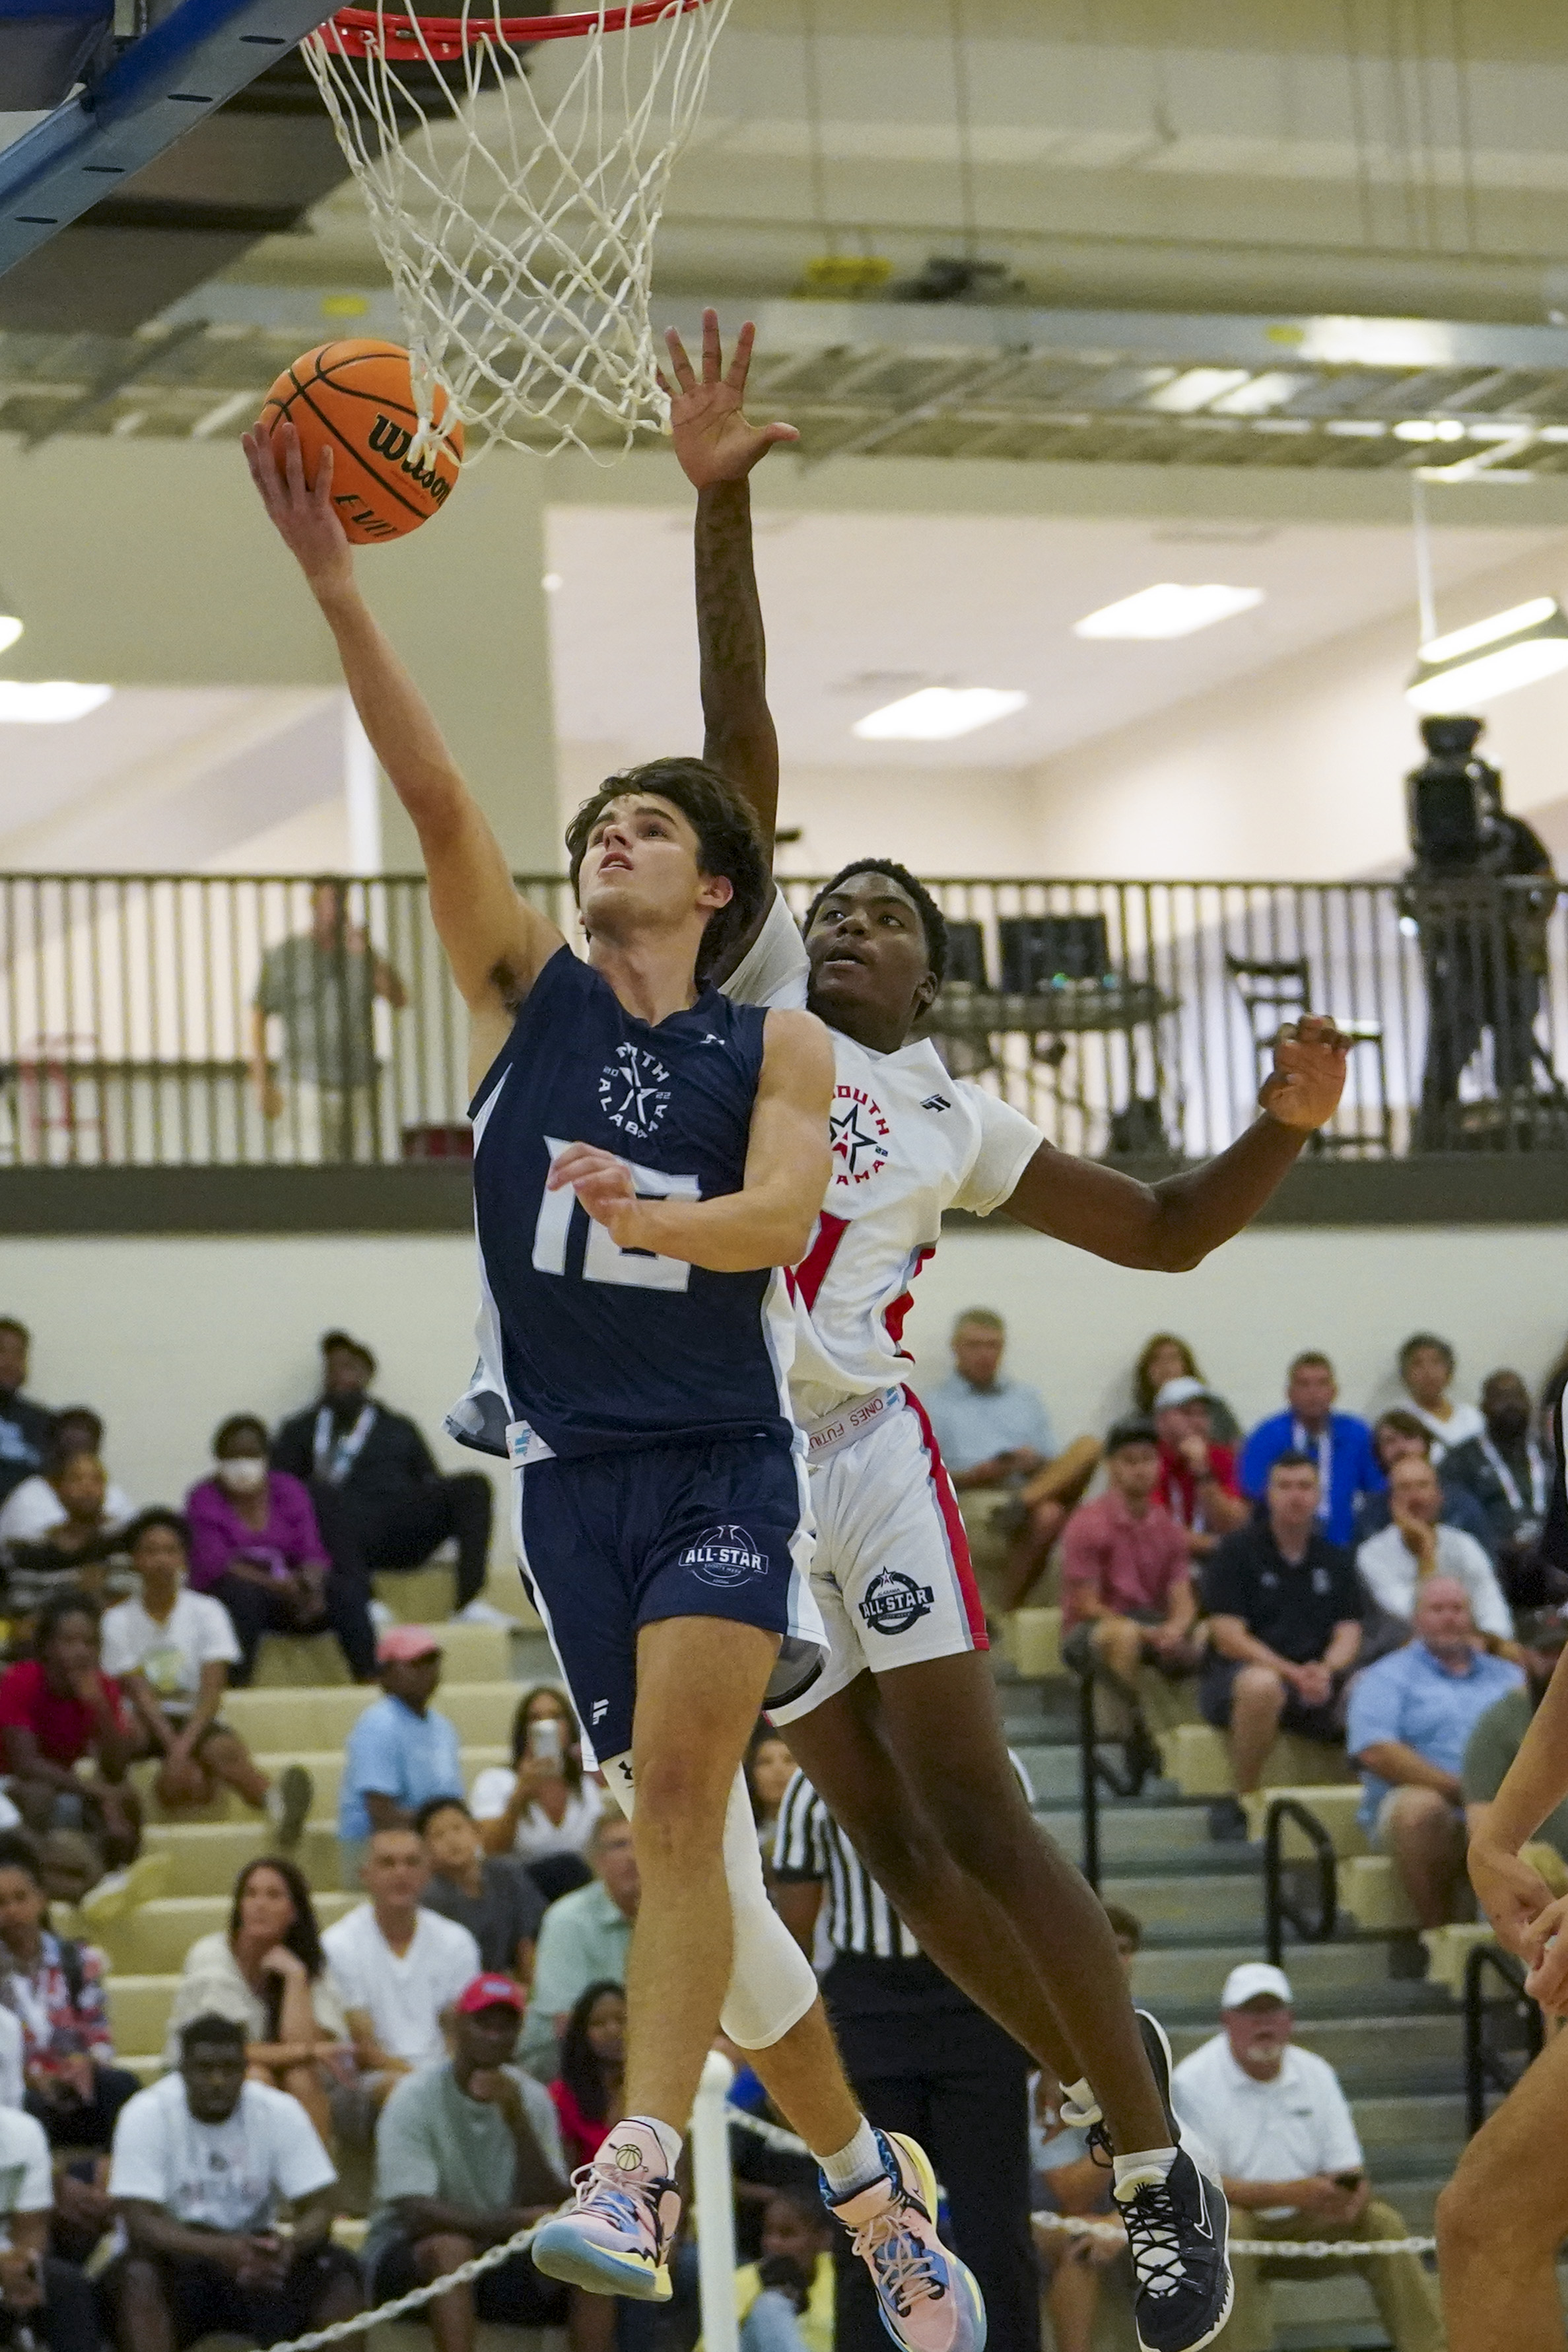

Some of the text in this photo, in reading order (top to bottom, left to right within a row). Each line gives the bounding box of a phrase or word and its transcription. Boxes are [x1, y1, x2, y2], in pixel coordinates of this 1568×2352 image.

[833, 1085, 890, 1136] OUTH
[685, 1548, 762, 1570] ALL-STAR
[862, 1589, 928, 1618] ALL-STAR
